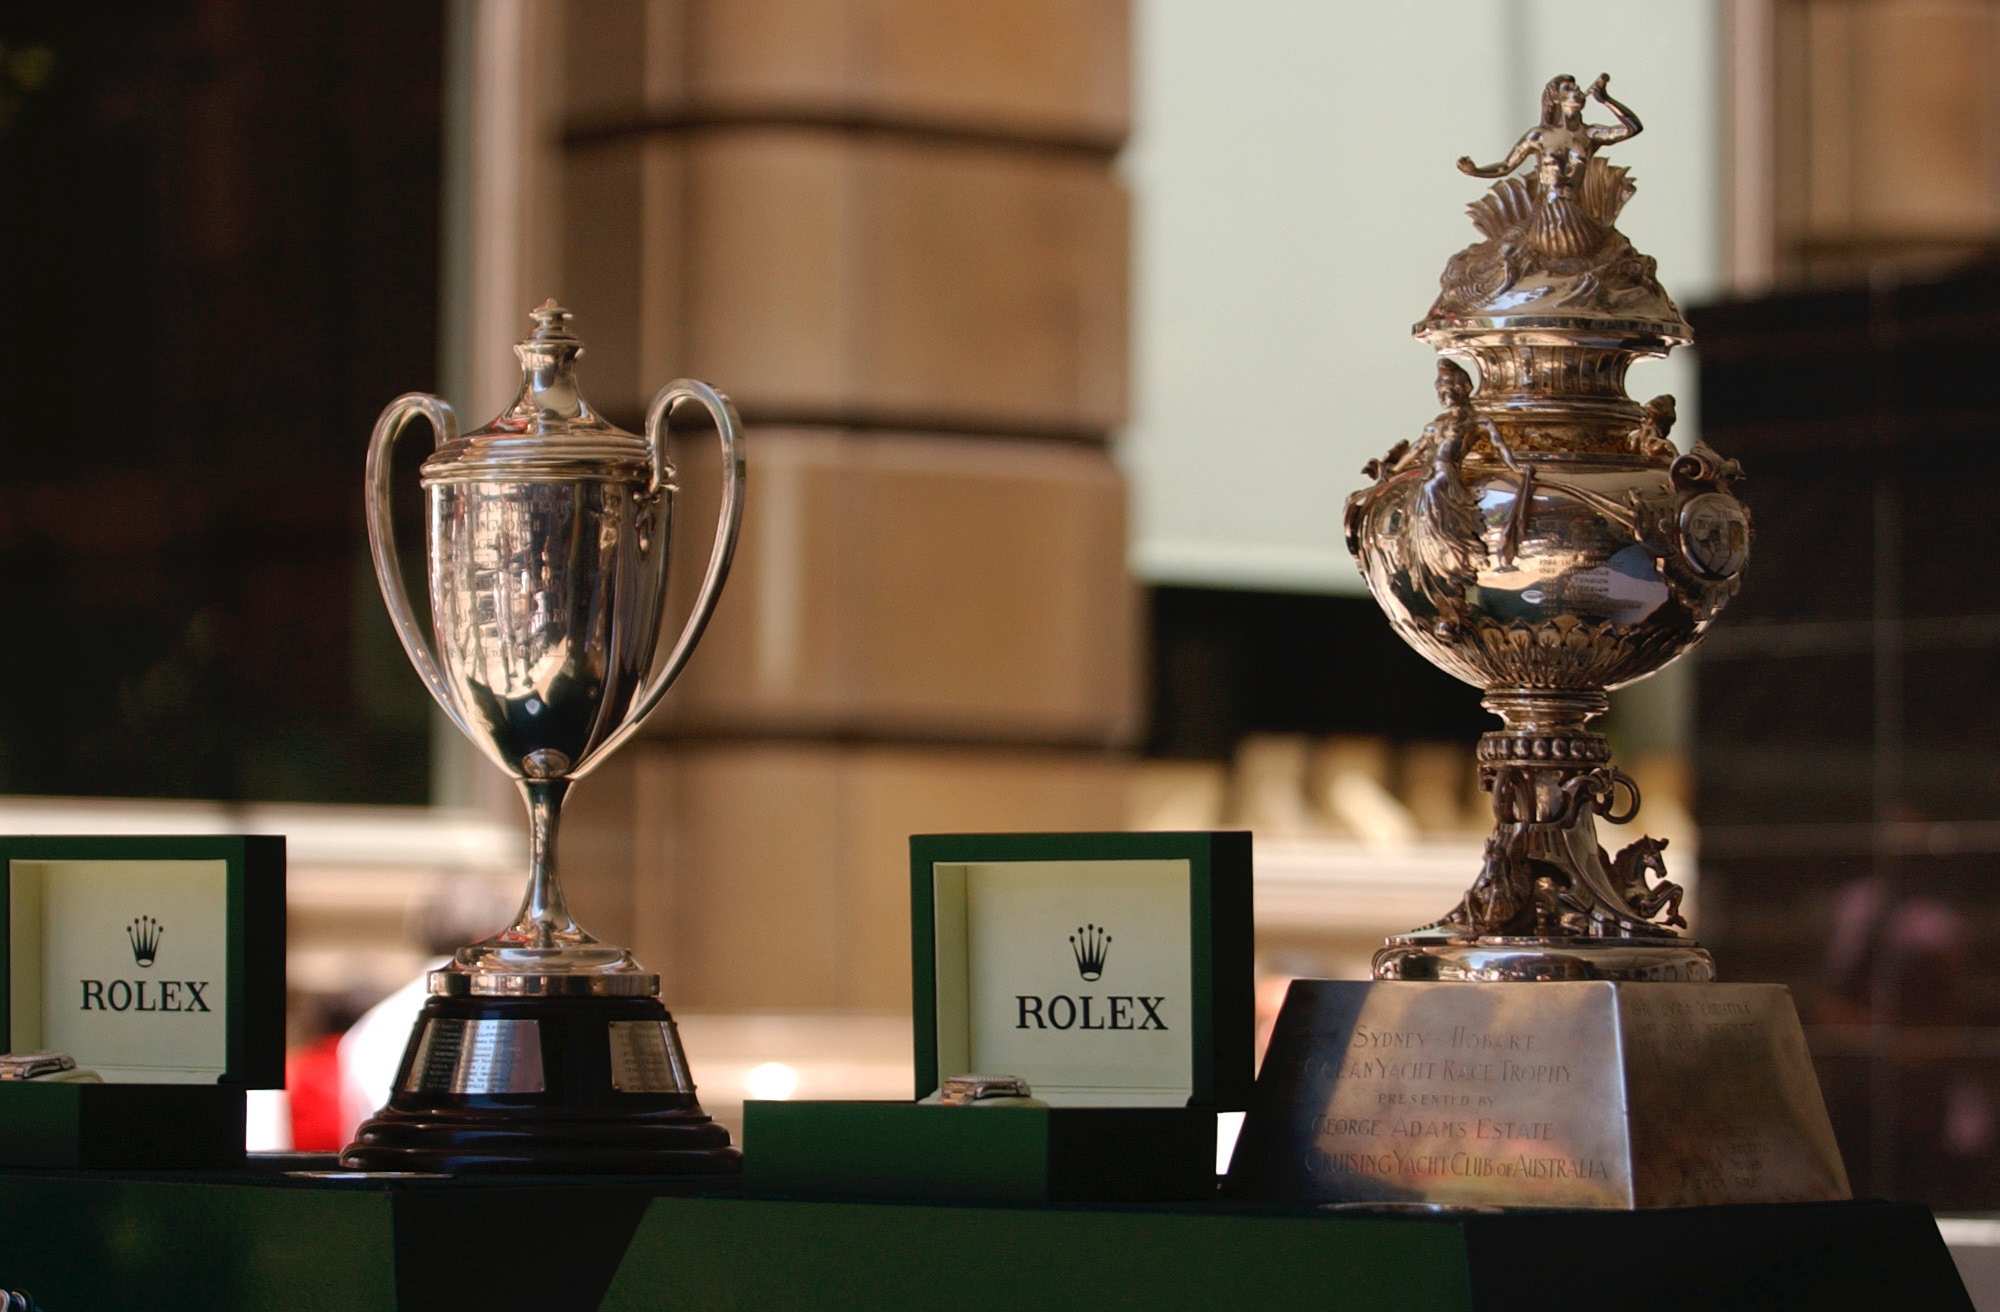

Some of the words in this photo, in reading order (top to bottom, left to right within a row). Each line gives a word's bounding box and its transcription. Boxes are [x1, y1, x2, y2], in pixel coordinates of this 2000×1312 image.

[80, 980, 211, 1012] ROLEX
[1016, 995, 1168, 1030] ROLEX
[1353, 1025, 1424, 1048] SYDNEY
[1376, 1058, 1436, 1080] YACHT
[1502, 1060, 1572, 1082] TROPHY
[1392, 1115, 1466, 1138] ADAMS
[1477, 1118, 1553, 1141] ESTATE
[1450, 1152, 1493, 1176] CLUB
[1514, 1154, 1609, 1179] AUSTRALIA
